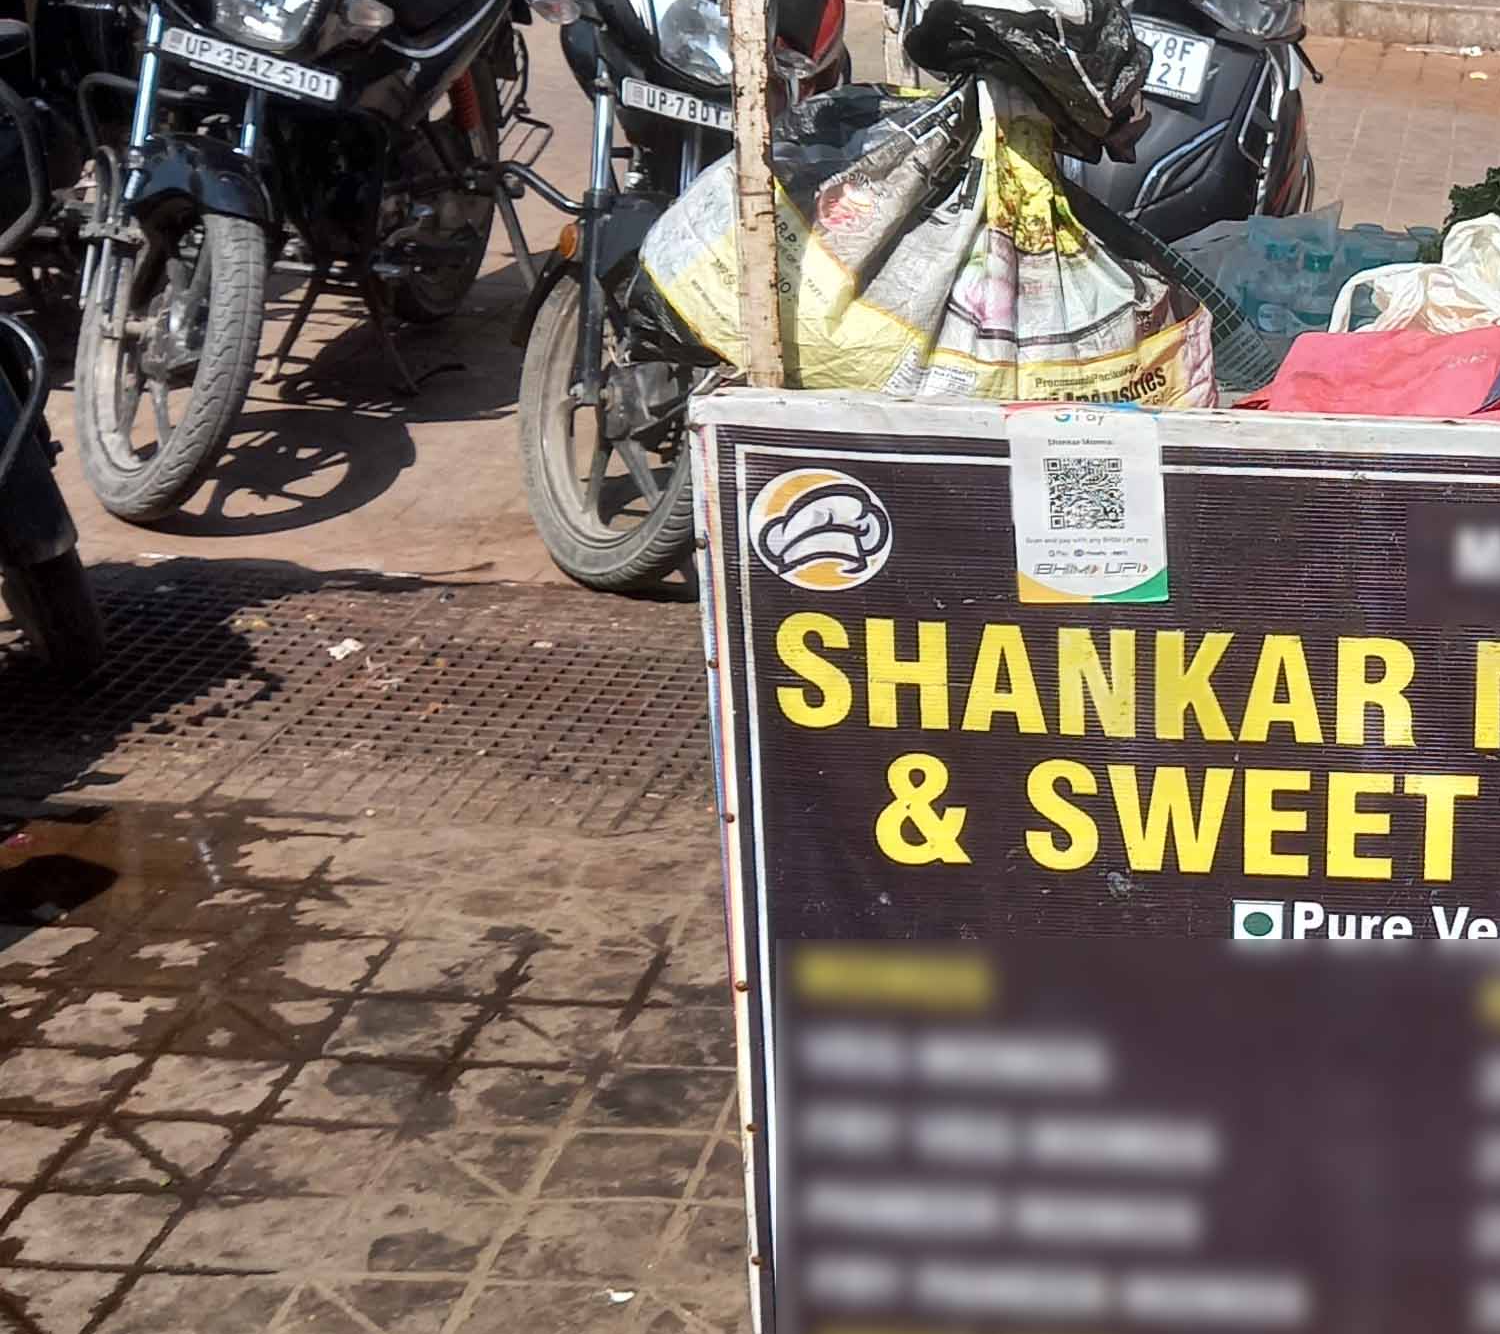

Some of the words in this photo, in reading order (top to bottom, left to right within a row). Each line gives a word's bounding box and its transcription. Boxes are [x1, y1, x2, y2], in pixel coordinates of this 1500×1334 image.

[775, 612, 1417, 747] SHANKAR
[875, 753, 973, 865] &
[1025, 759, 1480, 881] SWEET
[1292, 900, 1413, 940] Pure
